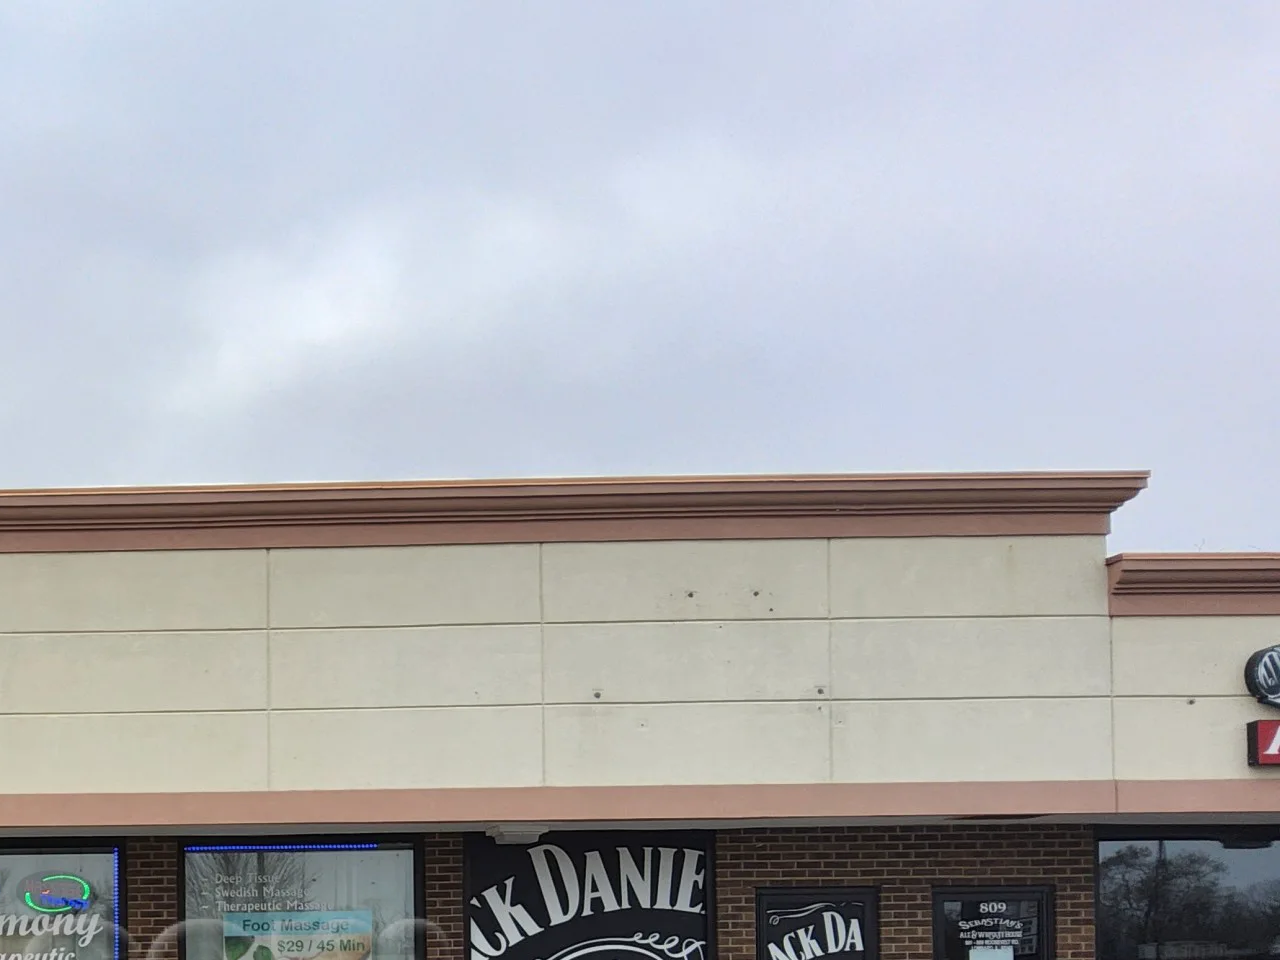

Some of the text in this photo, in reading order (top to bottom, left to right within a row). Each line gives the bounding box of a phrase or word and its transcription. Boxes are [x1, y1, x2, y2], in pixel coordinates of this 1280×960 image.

[215, 872, 281, 885] Deep Tissue
[215, 886, 313, 898] Swedish Massage
[215, 900, 335, 912] Therapeutic Massage
[979, 902, 1007, 913] 809
[242, 919, 350, 933] Foot Massage
[822, 911, 864, 953] DA
[277, 939, 304, 953] $29
[316, 939, 335, 952] 45
[339, 938, 365, 952] Min
